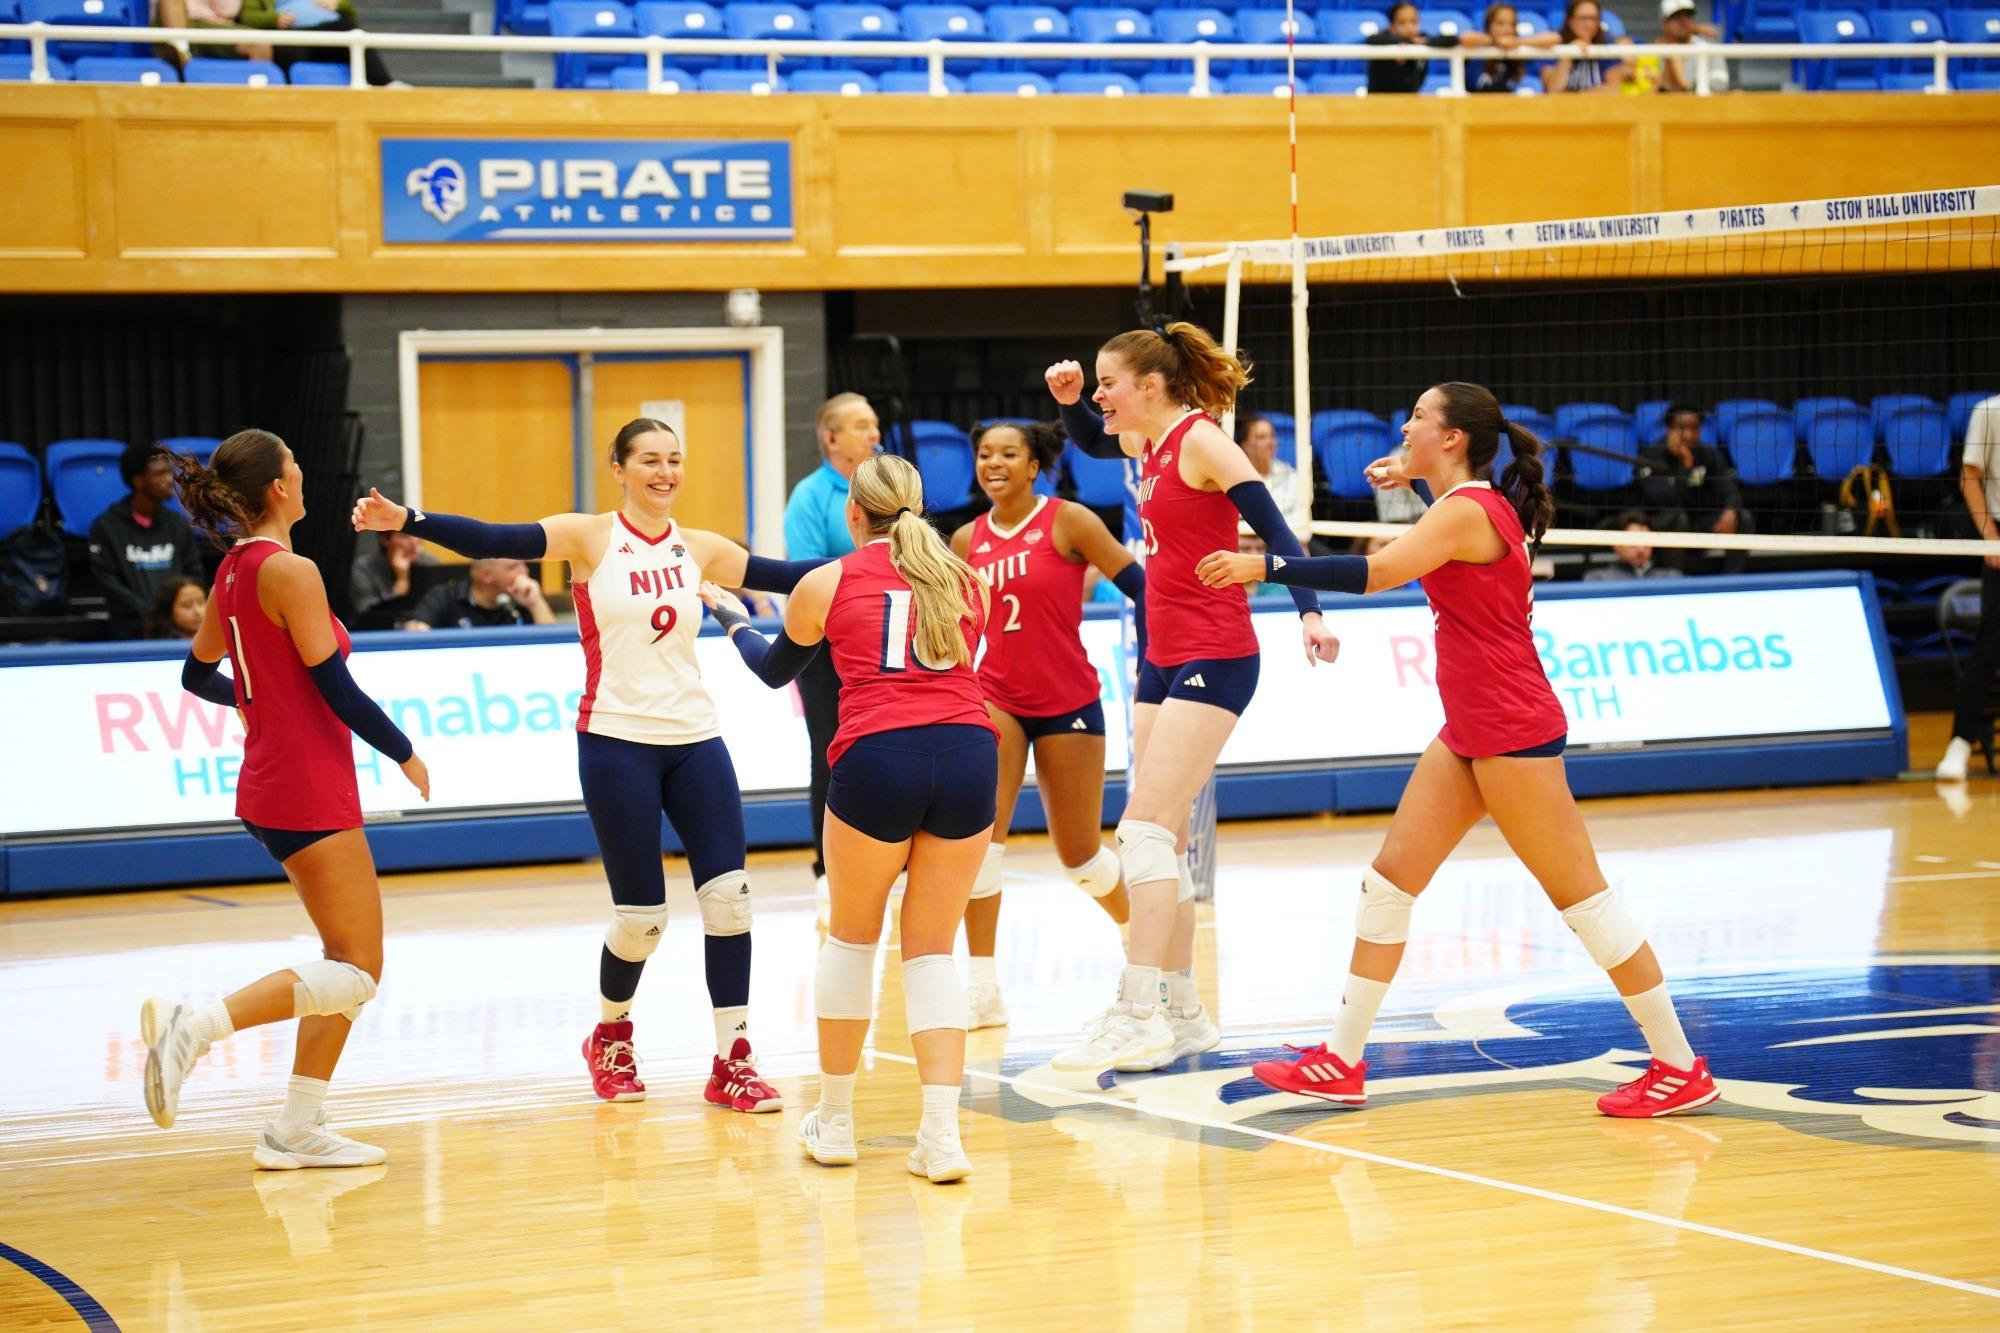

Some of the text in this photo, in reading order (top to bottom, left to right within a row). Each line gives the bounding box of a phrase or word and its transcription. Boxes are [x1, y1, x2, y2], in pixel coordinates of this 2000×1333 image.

[479, 159, 772, 199] PIRATE
[478, 204, 772, 222] ATHLETICS
[1719, 208, 1765, 229] PIRATES
[1826, 189, 1977, 221] SETON HALL UNIVERSITY
[1446, 229, 1485, 248] PIRATES
[1536, 216, 1660, 242] SETON HALL UNIVERSITY
[1320, 240, 1342, 256] HALL
[1344, 236, 1396, 254] UNIVERSITY
[629, 565, 685, 599] NJIT
[978, 550, 1031, 592] NJIT
[650, 605, 677, 645] 9
[1002, 594, 1022, 632] 2
[228, 616, 252, 705] 1
